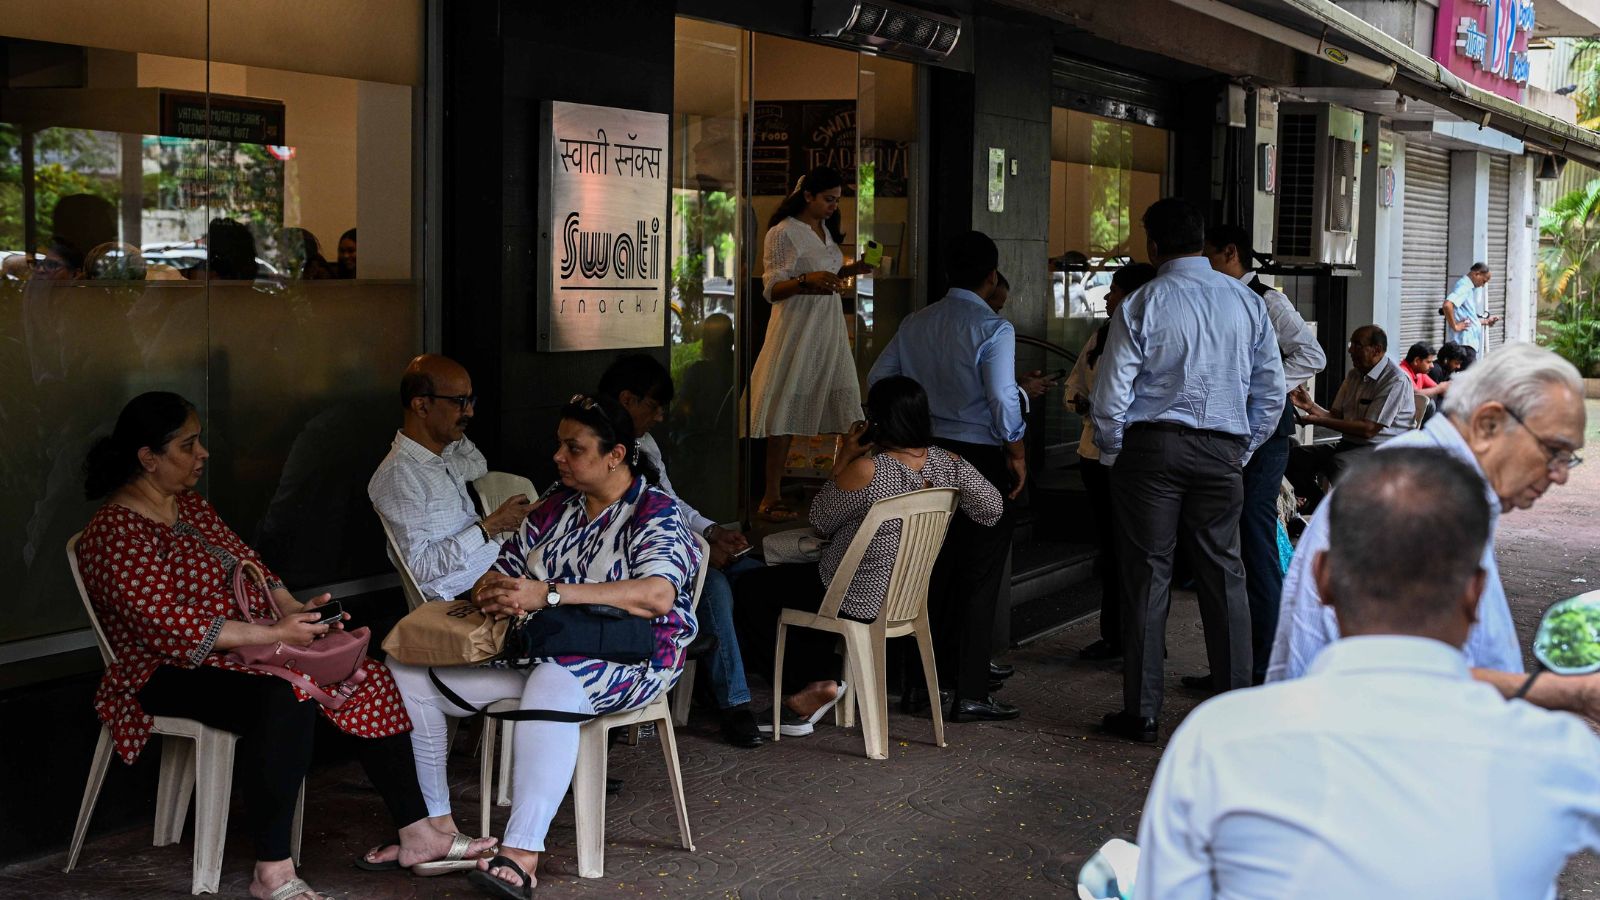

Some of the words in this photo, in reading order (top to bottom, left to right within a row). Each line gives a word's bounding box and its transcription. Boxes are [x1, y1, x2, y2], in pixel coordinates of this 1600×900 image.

[813, 110, 856, 147] SWAT
[560, 128, 610, 175] स्वाती
[560, 211, 660, 280] Swati
[560, 295, 658, 314] snacks
